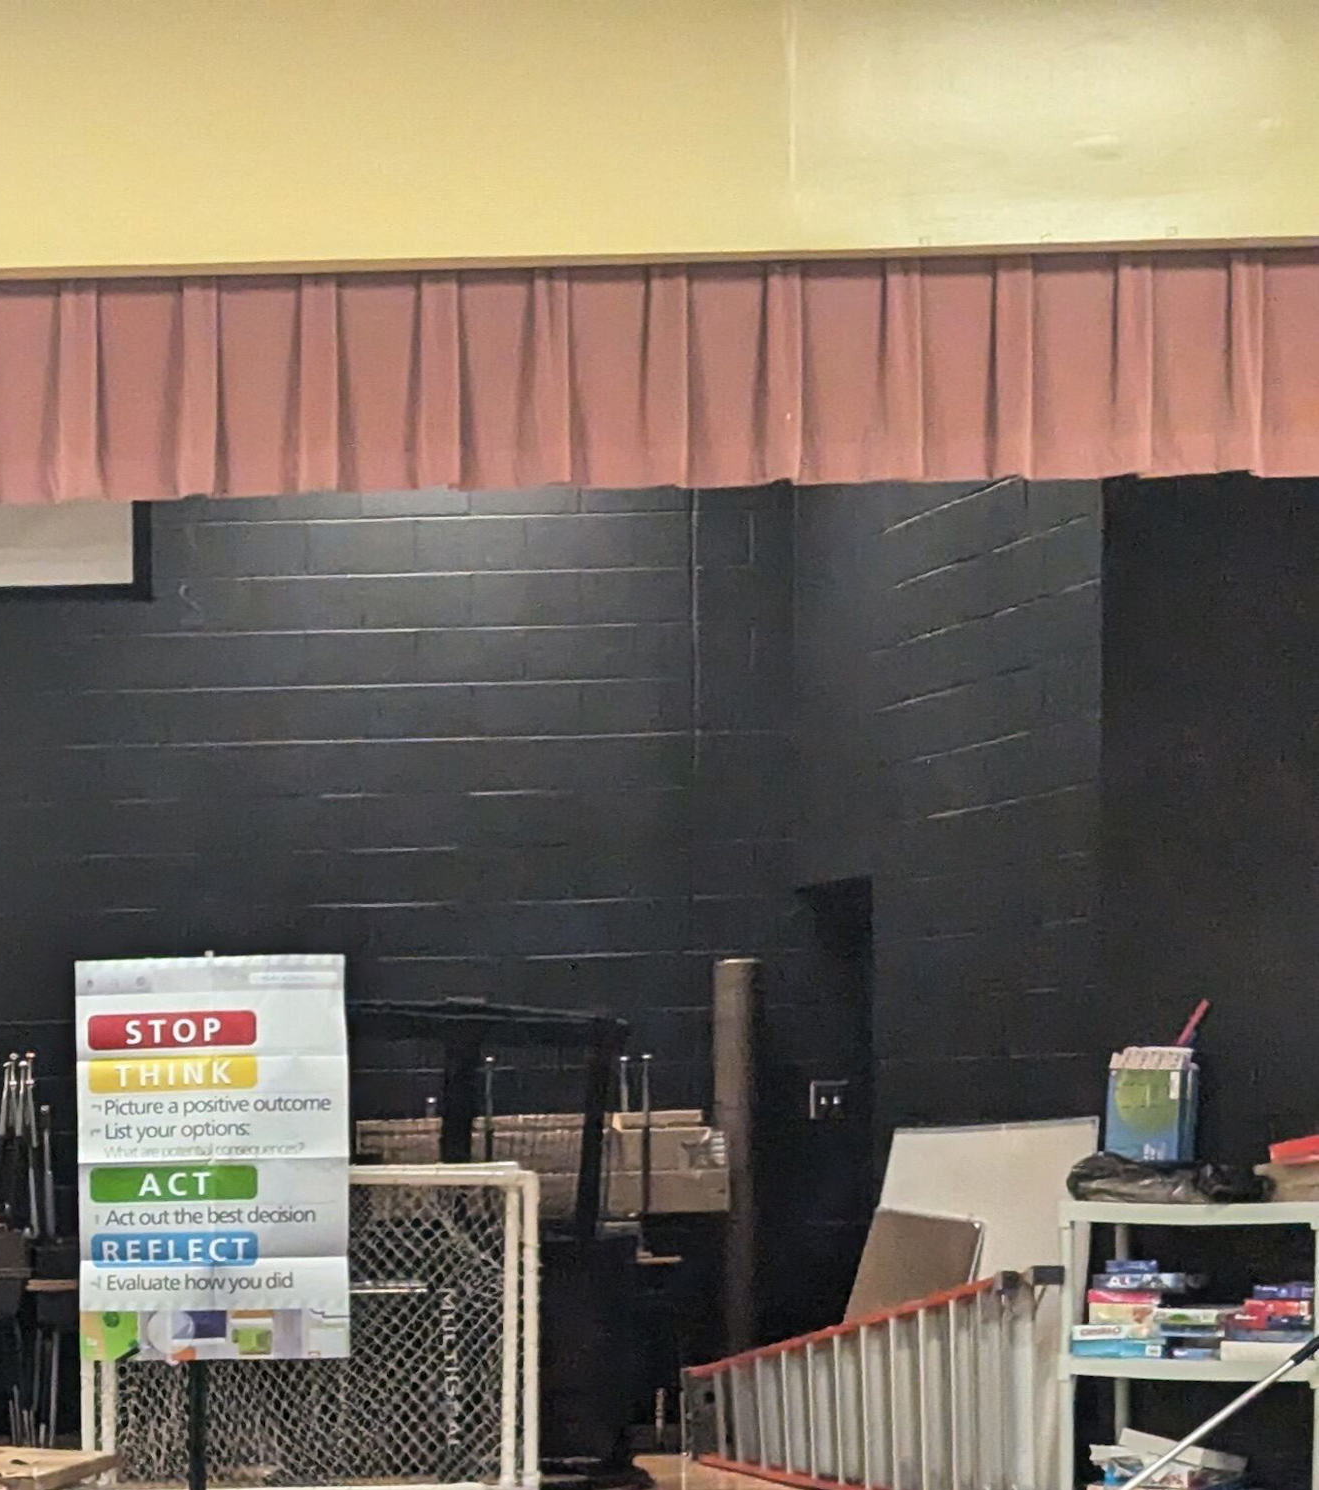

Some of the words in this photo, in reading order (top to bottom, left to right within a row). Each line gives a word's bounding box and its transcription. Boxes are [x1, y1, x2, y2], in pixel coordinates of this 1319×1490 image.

[125, 1017, 222, 1045] STOP
[115, 1060, 232, 1088] THINK
[104, 1098, 163, 1116] Picture
[167, 1101, 179, 1114] a
[183, 1097, 250, 1117] positive
[253, 1097, 331, 1112] outcome
[104, 1123, 132, 1140] List
[137, 1124, 177, 1143] your
[181, 1121, 250, 1141] options:
[104, 1145, 138, 1158] What
[143, 1147, 159, 1158] are
[216, 1142, 305, 1158] consequences?
[138, 1172, 211, 1197] ACT
[105, 1210, 134, 1226] Act
[139, 1209, 170, 1225] out
[174, 1208, 203, 1224] the
[207, 1206, 243, 1224] best
[247, 1206, 316, 1223] decision
[101, 1237, 250, 1264] REFLECT
[106, 1274, 181, 1291] Evaluate
[184, 1273, 226, 1291] how
[228, 1276, 262, 1294] you
[265, 1271, 293, 1289] did
